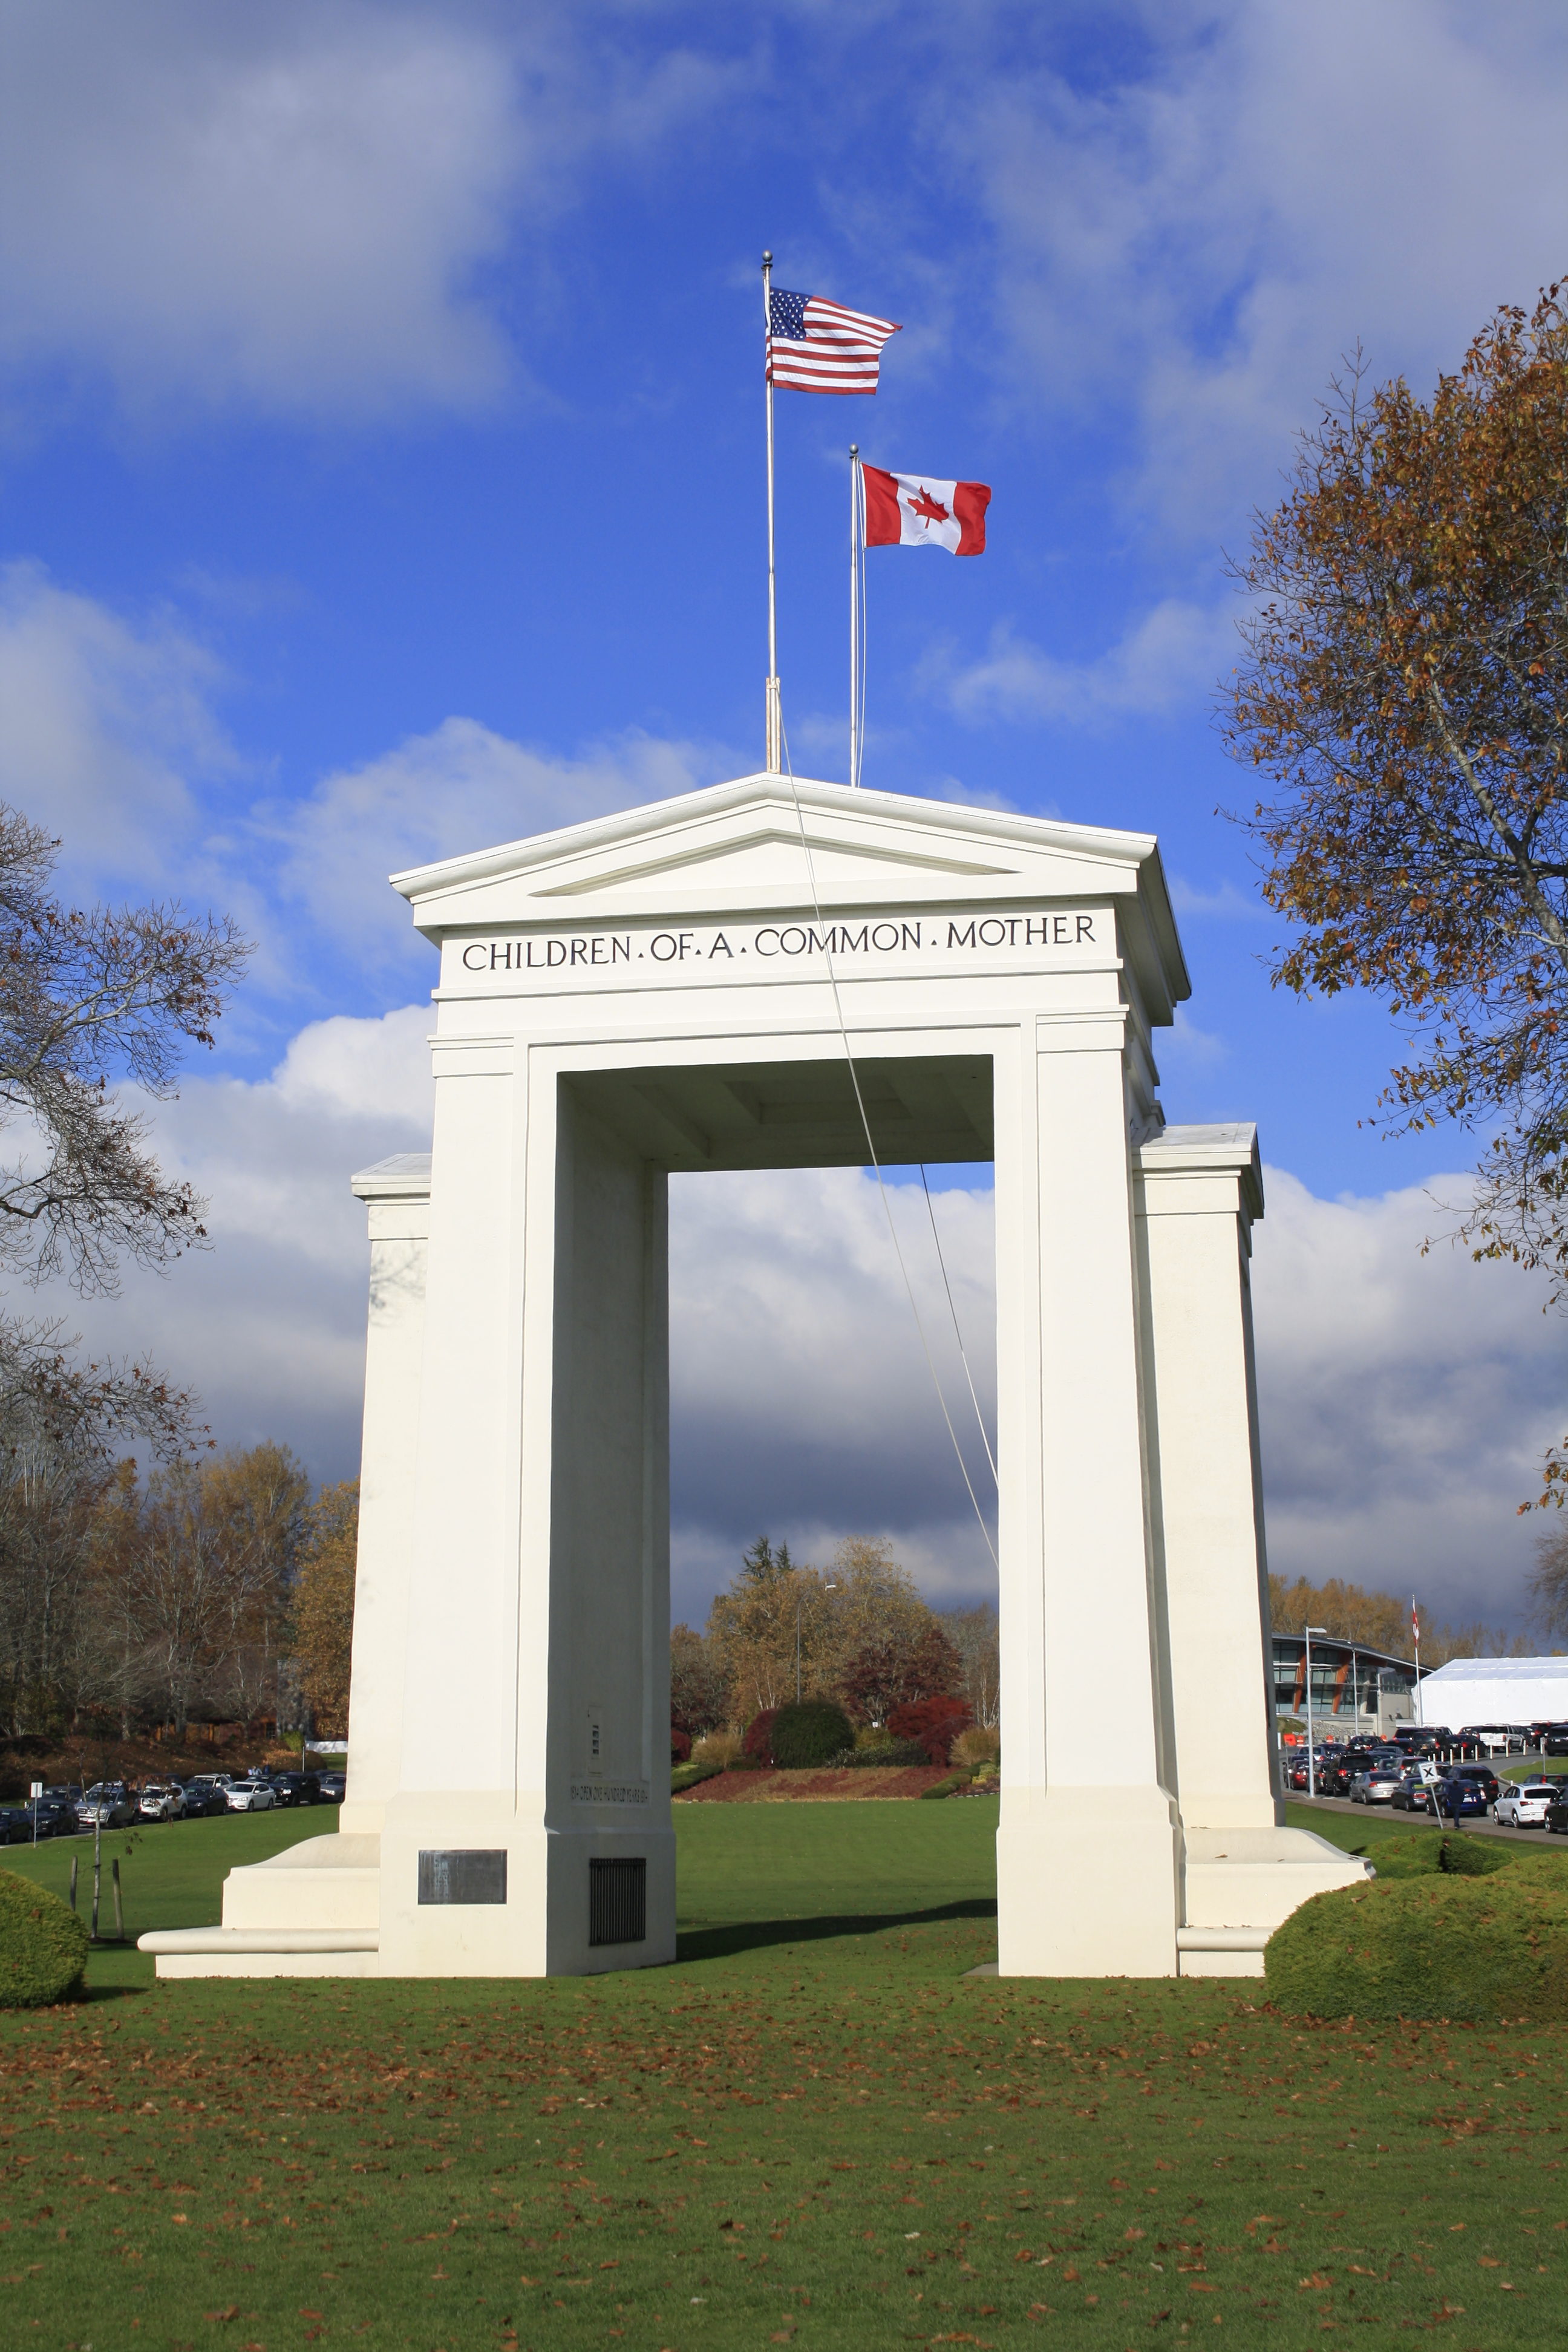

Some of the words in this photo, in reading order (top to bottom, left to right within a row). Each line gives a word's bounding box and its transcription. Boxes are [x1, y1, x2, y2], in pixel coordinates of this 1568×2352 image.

[463, 936, 631, 971] CHILDREN
[650, 933, 694, 961] OF
[708, 932, 734, 959] A
[755, 922, 921, 956] COMMON
[947, 916, 1097, 949] MOTHER
[580, 1786, 592, 1800] OPEN
